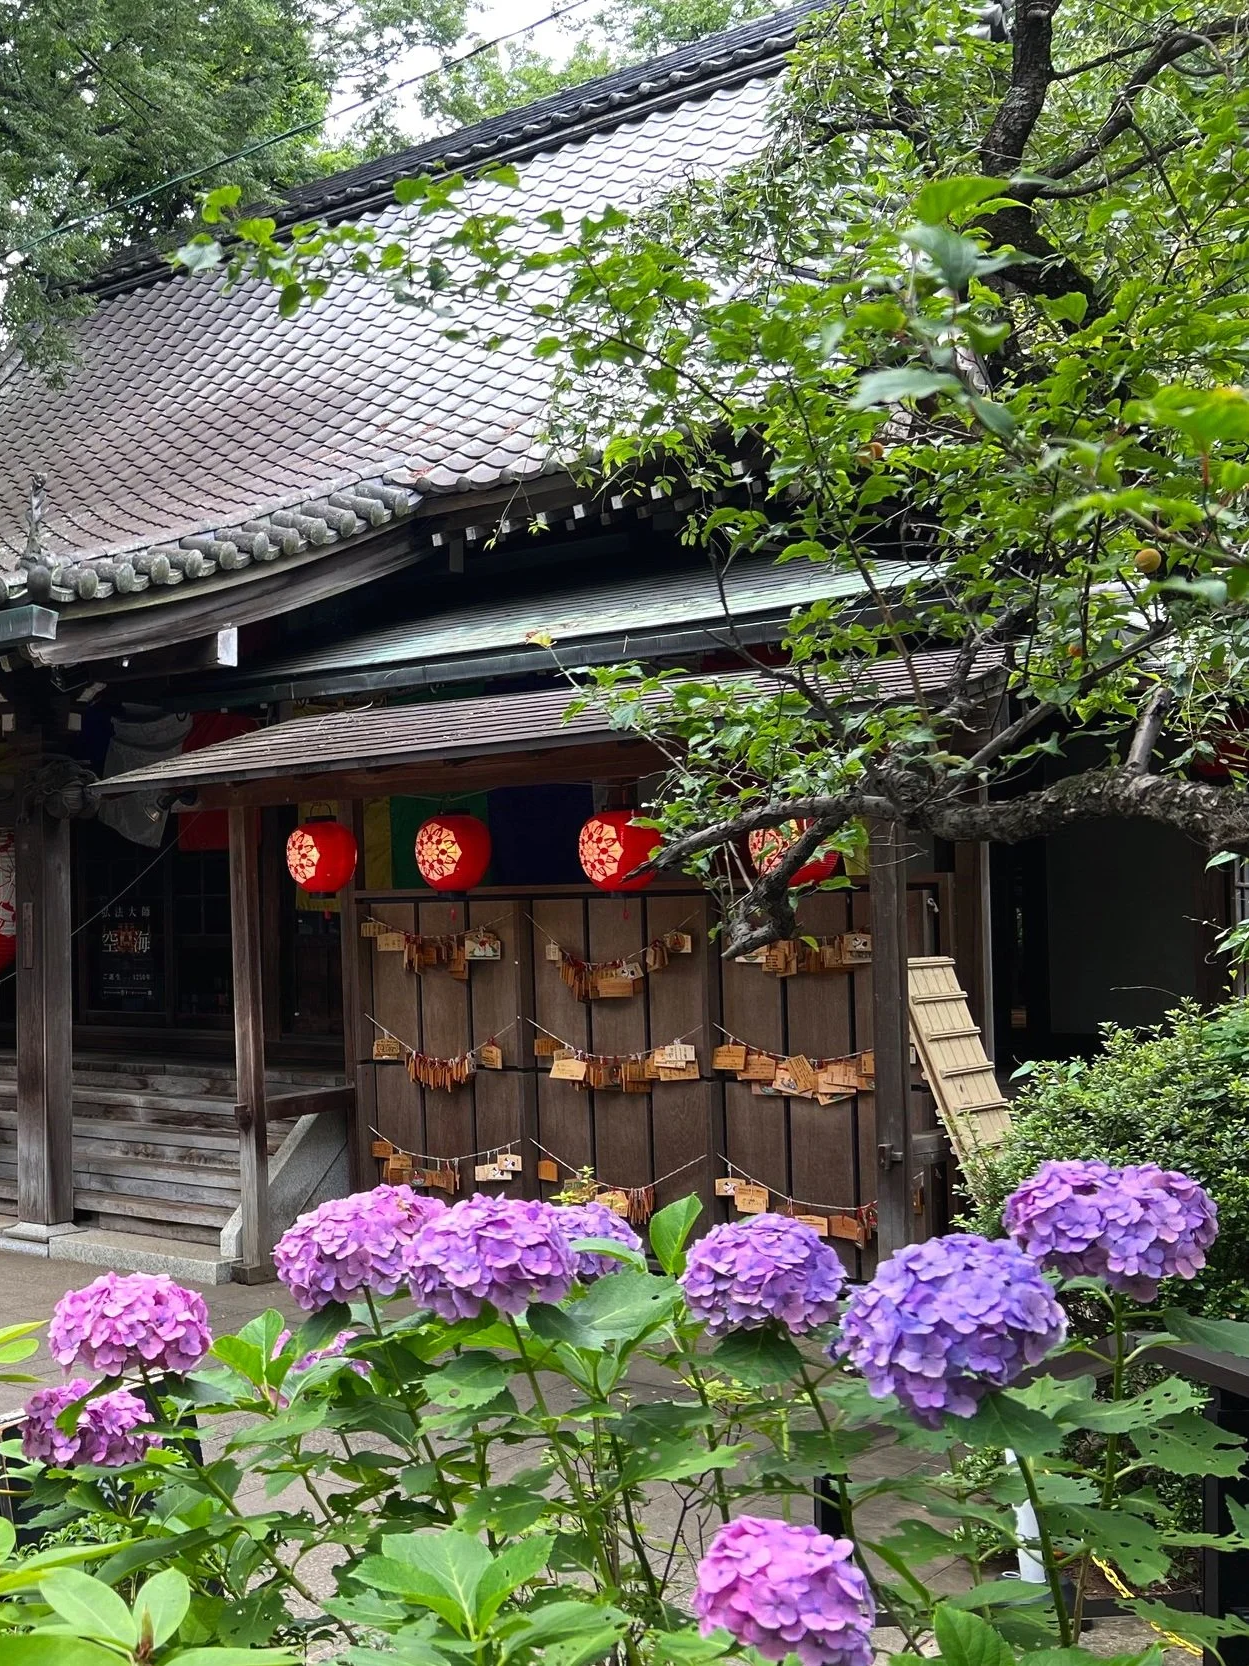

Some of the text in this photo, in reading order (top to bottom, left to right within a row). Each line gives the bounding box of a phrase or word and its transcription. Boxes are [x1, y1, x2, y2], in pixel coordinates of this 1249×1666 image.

[101, 905, 151, 918] 弘法大師
[102, 930, 151, 953] 空海
